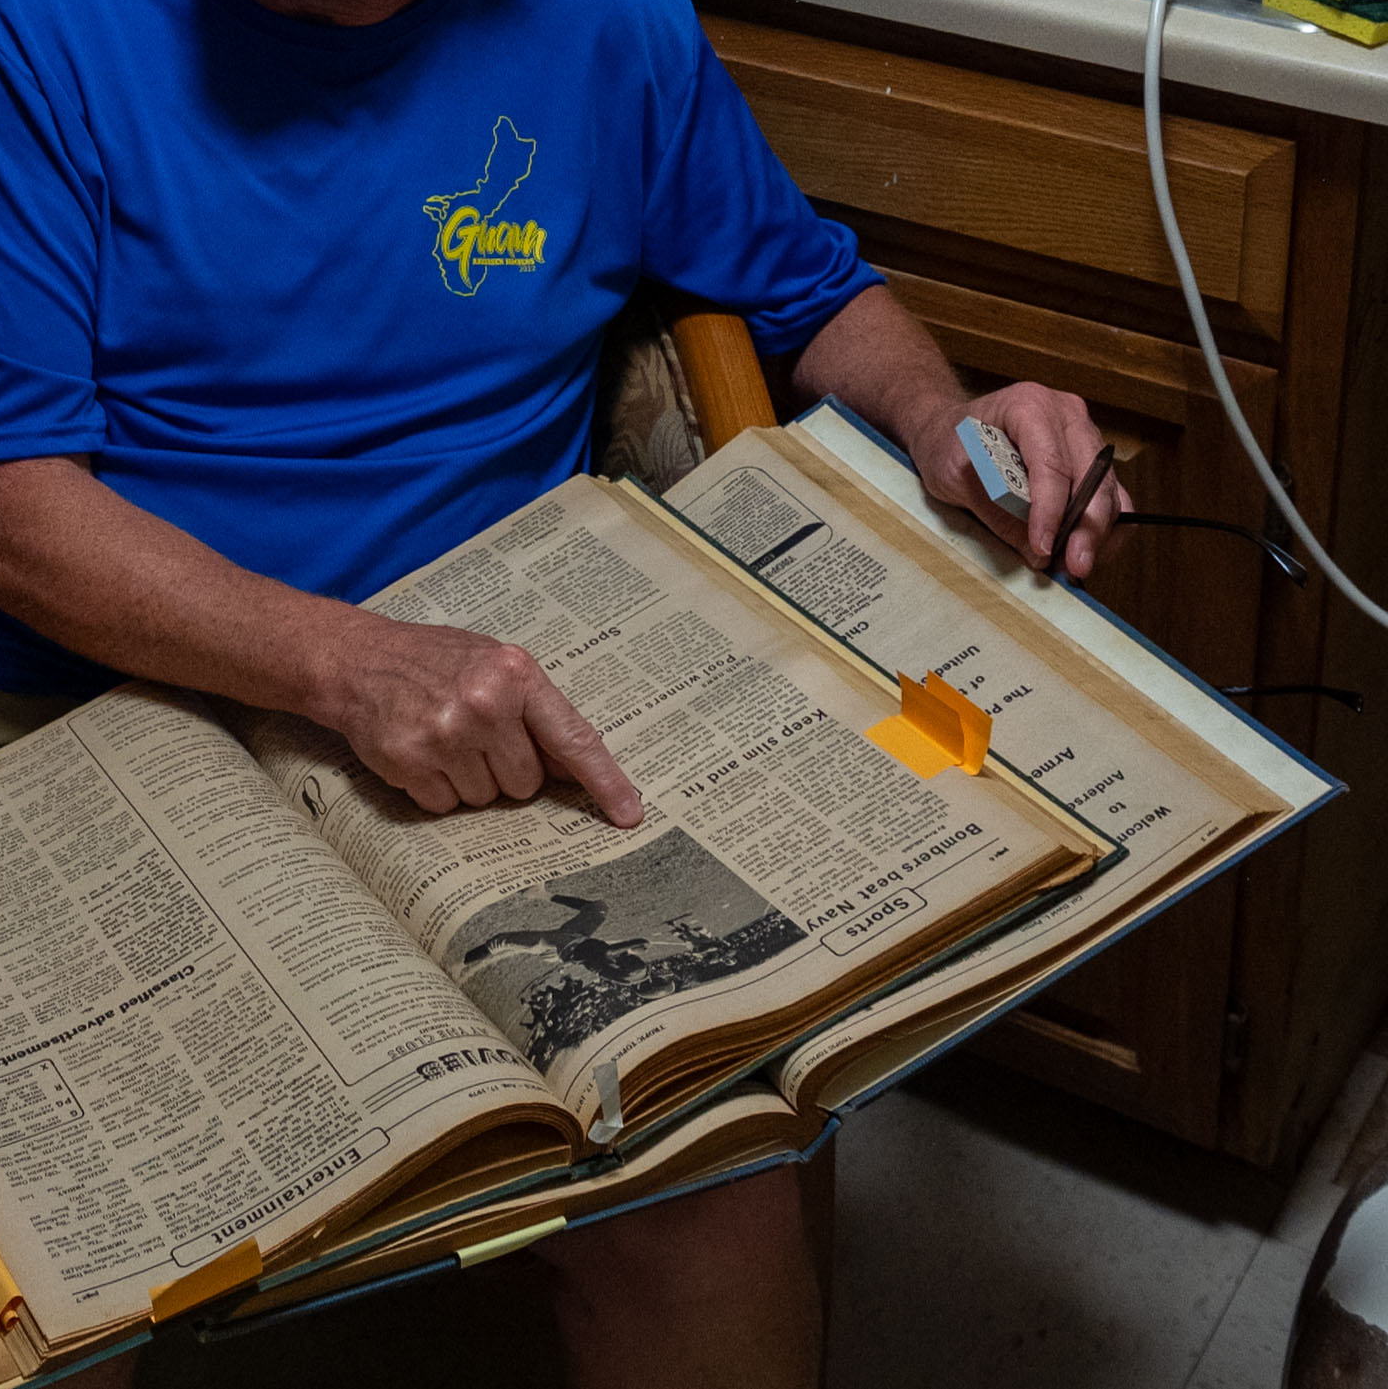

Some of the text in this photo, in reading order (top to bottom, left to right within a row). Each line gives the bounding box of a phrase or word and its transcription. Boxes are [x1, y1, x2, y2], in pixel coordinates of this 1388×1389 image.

[761, 554, 797, 580] TROPI
[566, 624, 621, 659] Sports
[546, 659, 564, 670] in
[703, 654, 736, 676] Pool
[933, 644, 981, 678] United
[645, 675, 700, 709] winners
[970, 676, 985, 690] of
[1003, 685, 1033, 703] The
[681, 708, 828, 798] Keep slim and fit
[1027, 746, 1077, 781] Arme
[1066, 769, 1126, 811] Anderse
[1109, 802, 1127, 813] to
[1114, 803, 1172, 843] Welcom
[902, 823, 983, 872] Bombers
[398, 838, 531, 919] Drinking curtailed
[565, 861, 590, 875] Run
[499, 883, 520, 894] run
[857, 871, 903, 899] beat
[807, 900, 855, 932] Navy
[846, 893, 909, 937] Sports
[119, 965, 195, 1013] Classified
[387, 1034, 434, 1060] CLUBS
[40, 1061, 48, 1071] X
[416, 1048, 519, 1081] OVIES
[56, 1097, 71, 1107] PG
[207, 1148, 365, 1243] Entertainment
